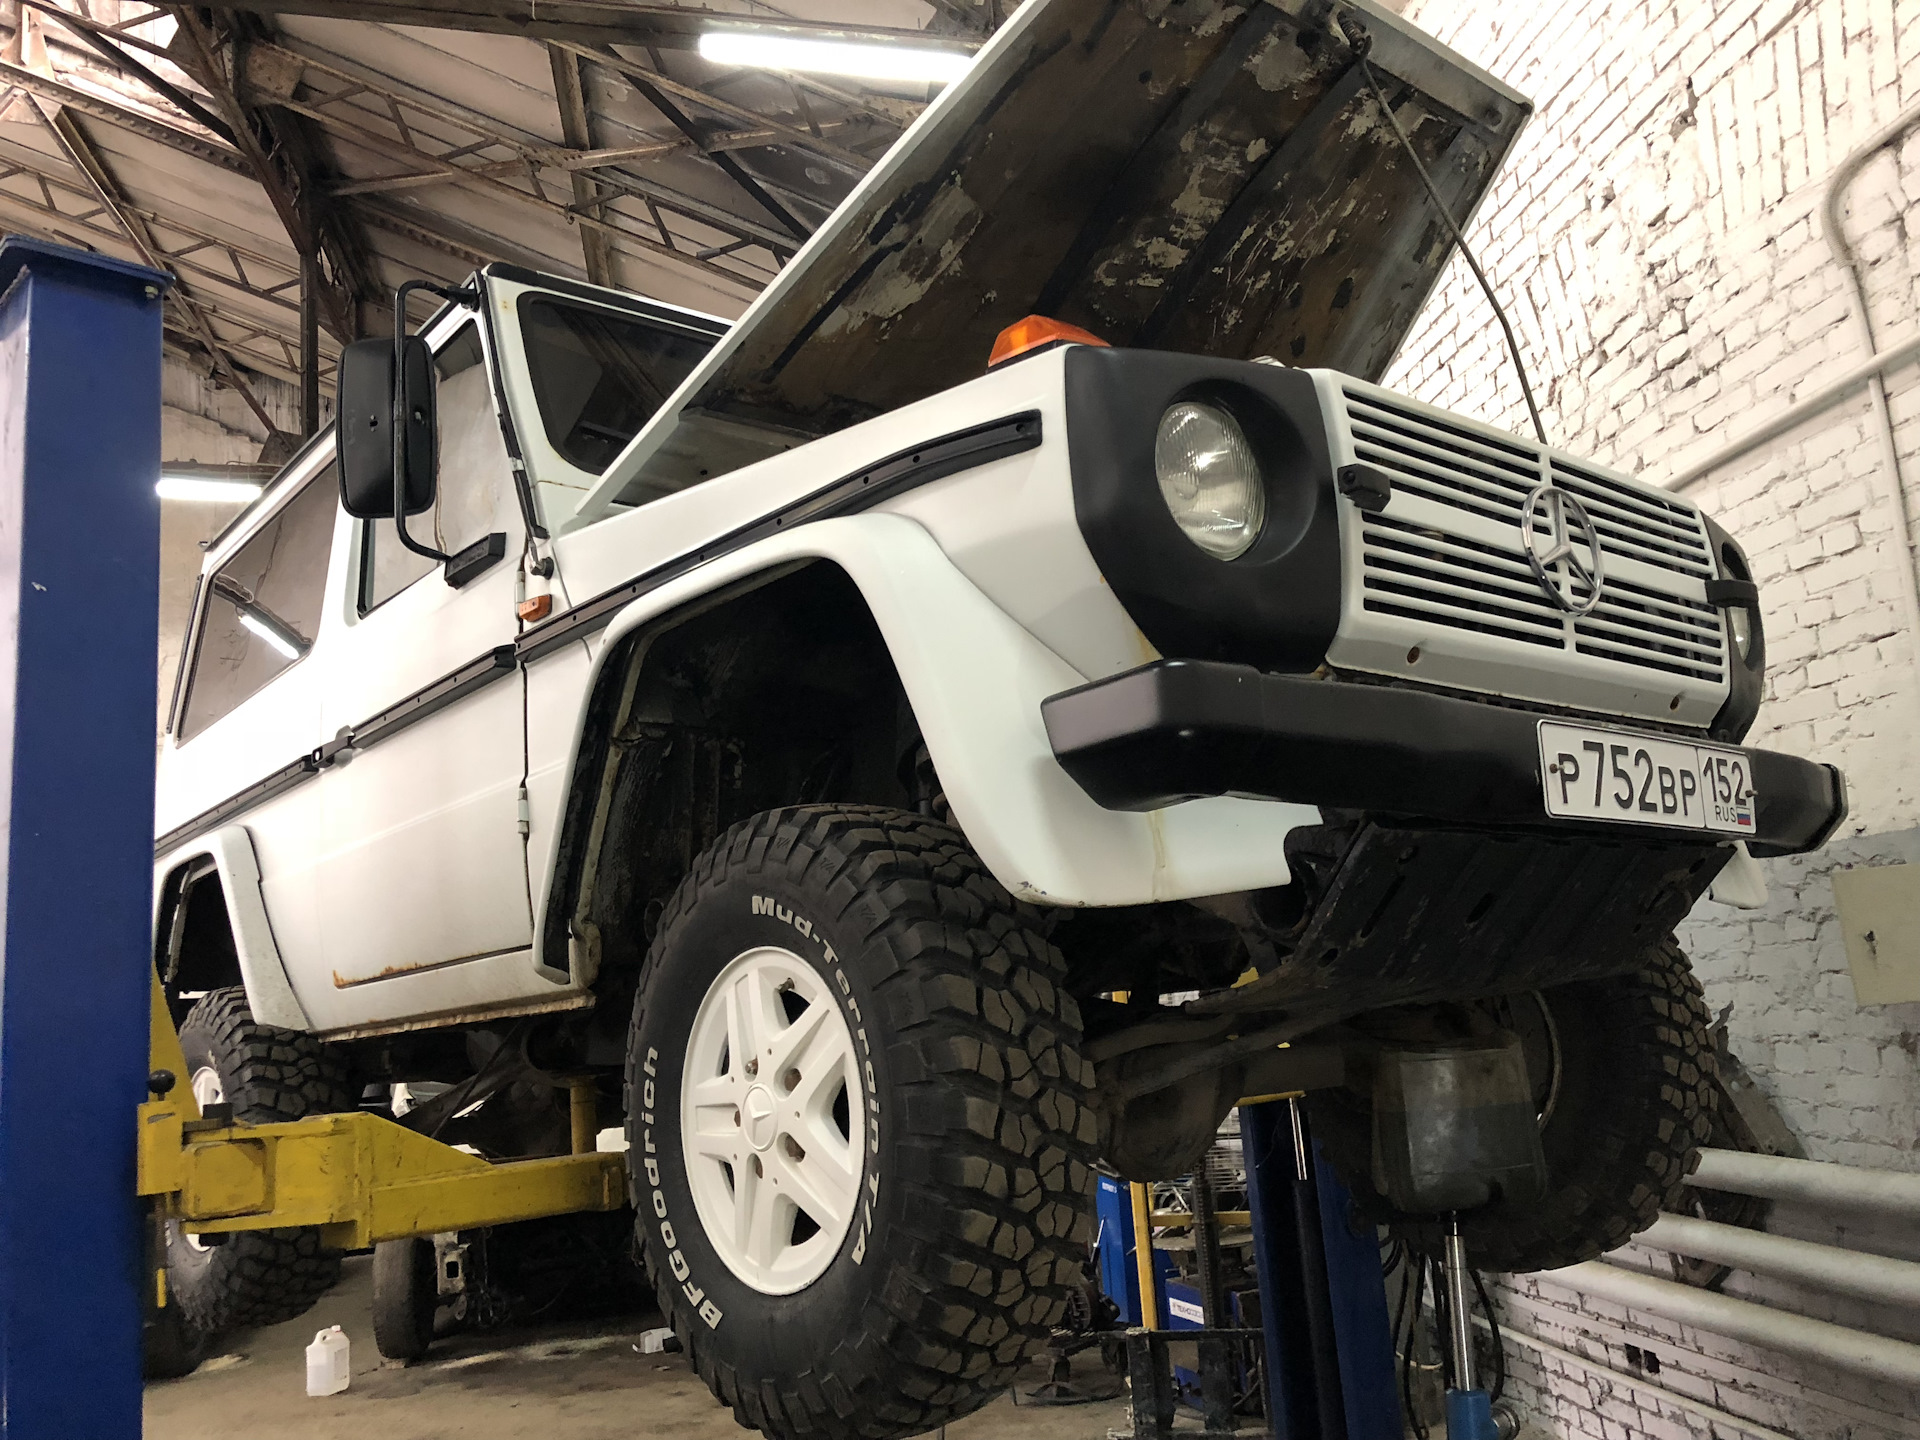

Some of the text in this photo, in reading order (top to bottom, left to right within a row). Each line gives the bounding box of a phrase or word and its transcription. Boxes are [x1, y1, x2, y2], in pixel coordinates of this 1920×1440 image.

[1703, 756, 1747, 806] 152
[1715, 805, 1737, 823] RUS
[751, 895, 881, 1265] Mud-Terrain T/A
[641, 1046, 723, 1330] BFGoodrich
